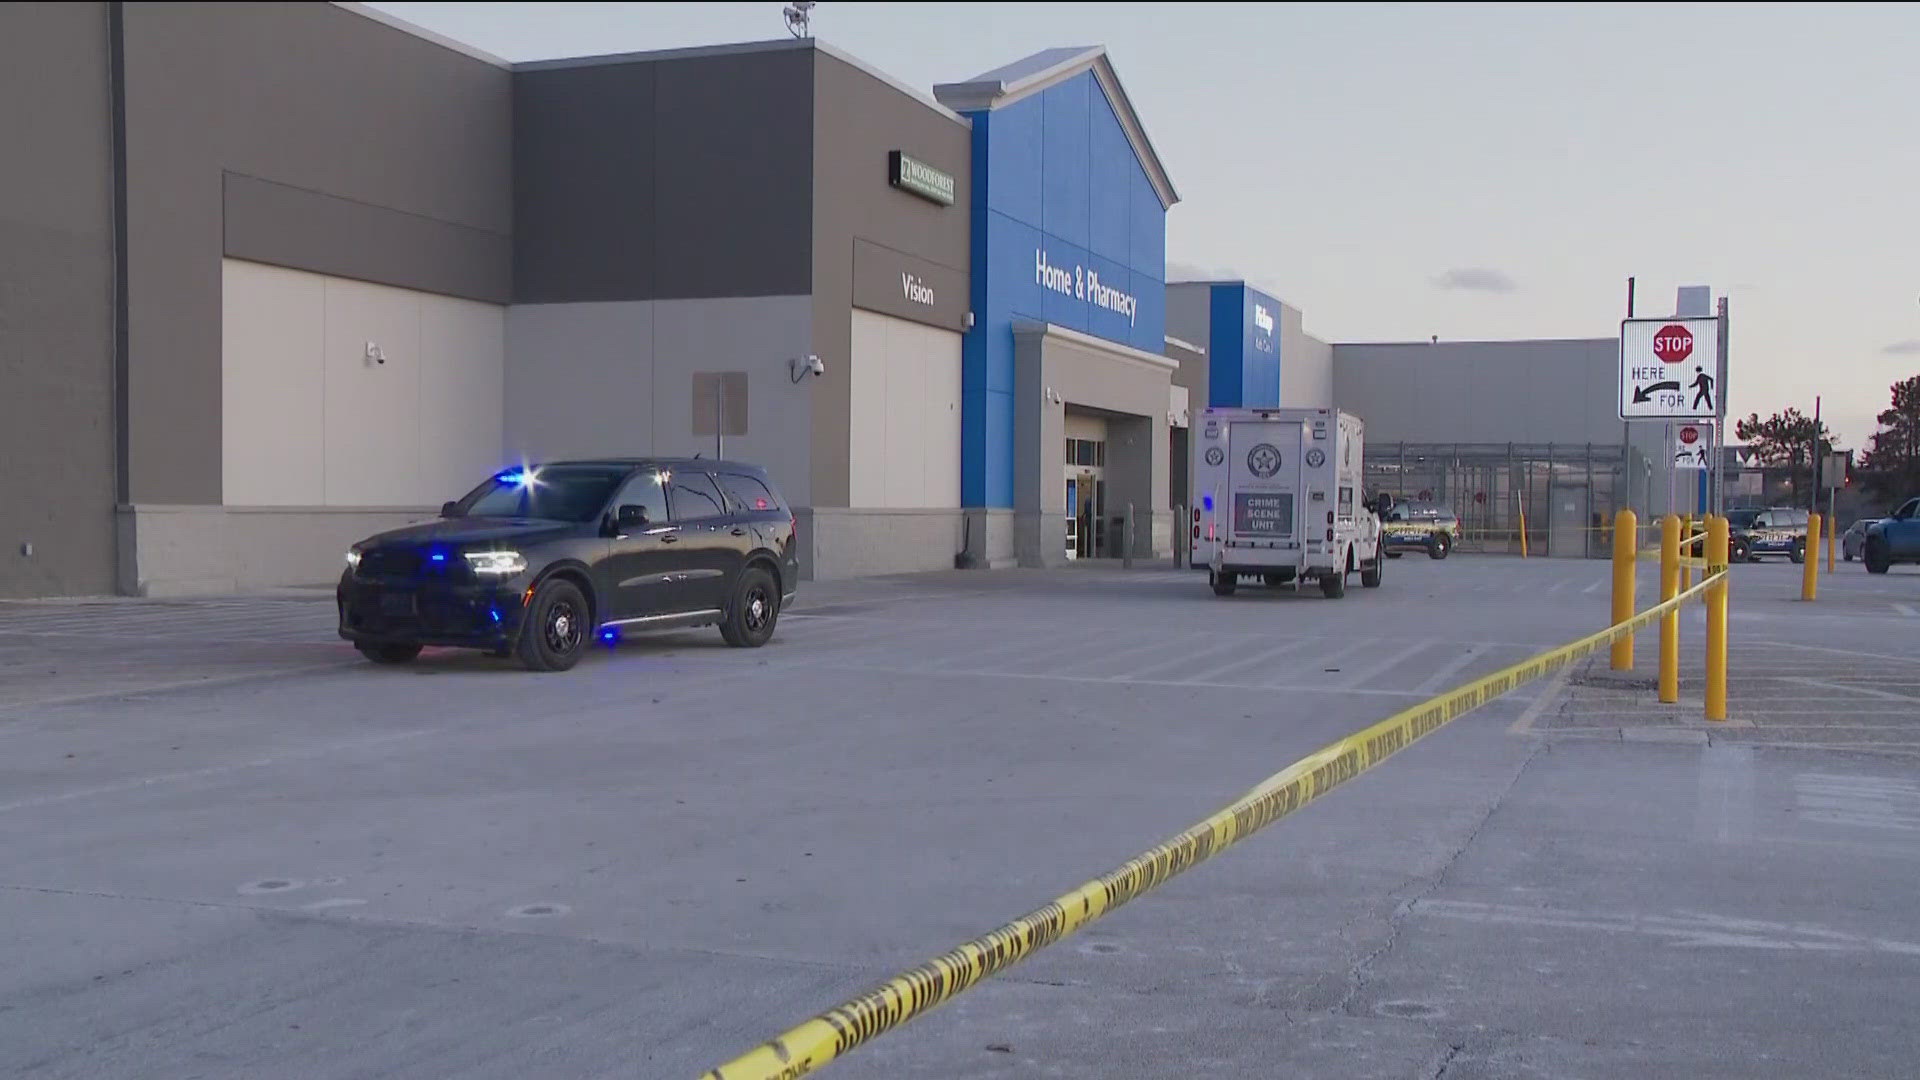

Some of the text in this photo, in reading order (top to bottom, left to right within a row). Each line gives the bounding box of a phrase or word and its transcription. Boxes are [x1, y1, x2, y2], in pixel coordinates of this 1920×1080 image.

[901, 271, 934, 305] Vision
[1035, 248, 1137, 328] Home & Pharmacy
[1655, 337, 1692, 352] STOP
[1632, 367, 1665, 380] HERE
[1660, 395, 1685, 407] FOR
[1247, 499, 1280, 508] CRIME
[1247, 509, 1280, 518] SCENE
[1251, 520, 1275, 530] UNIT
